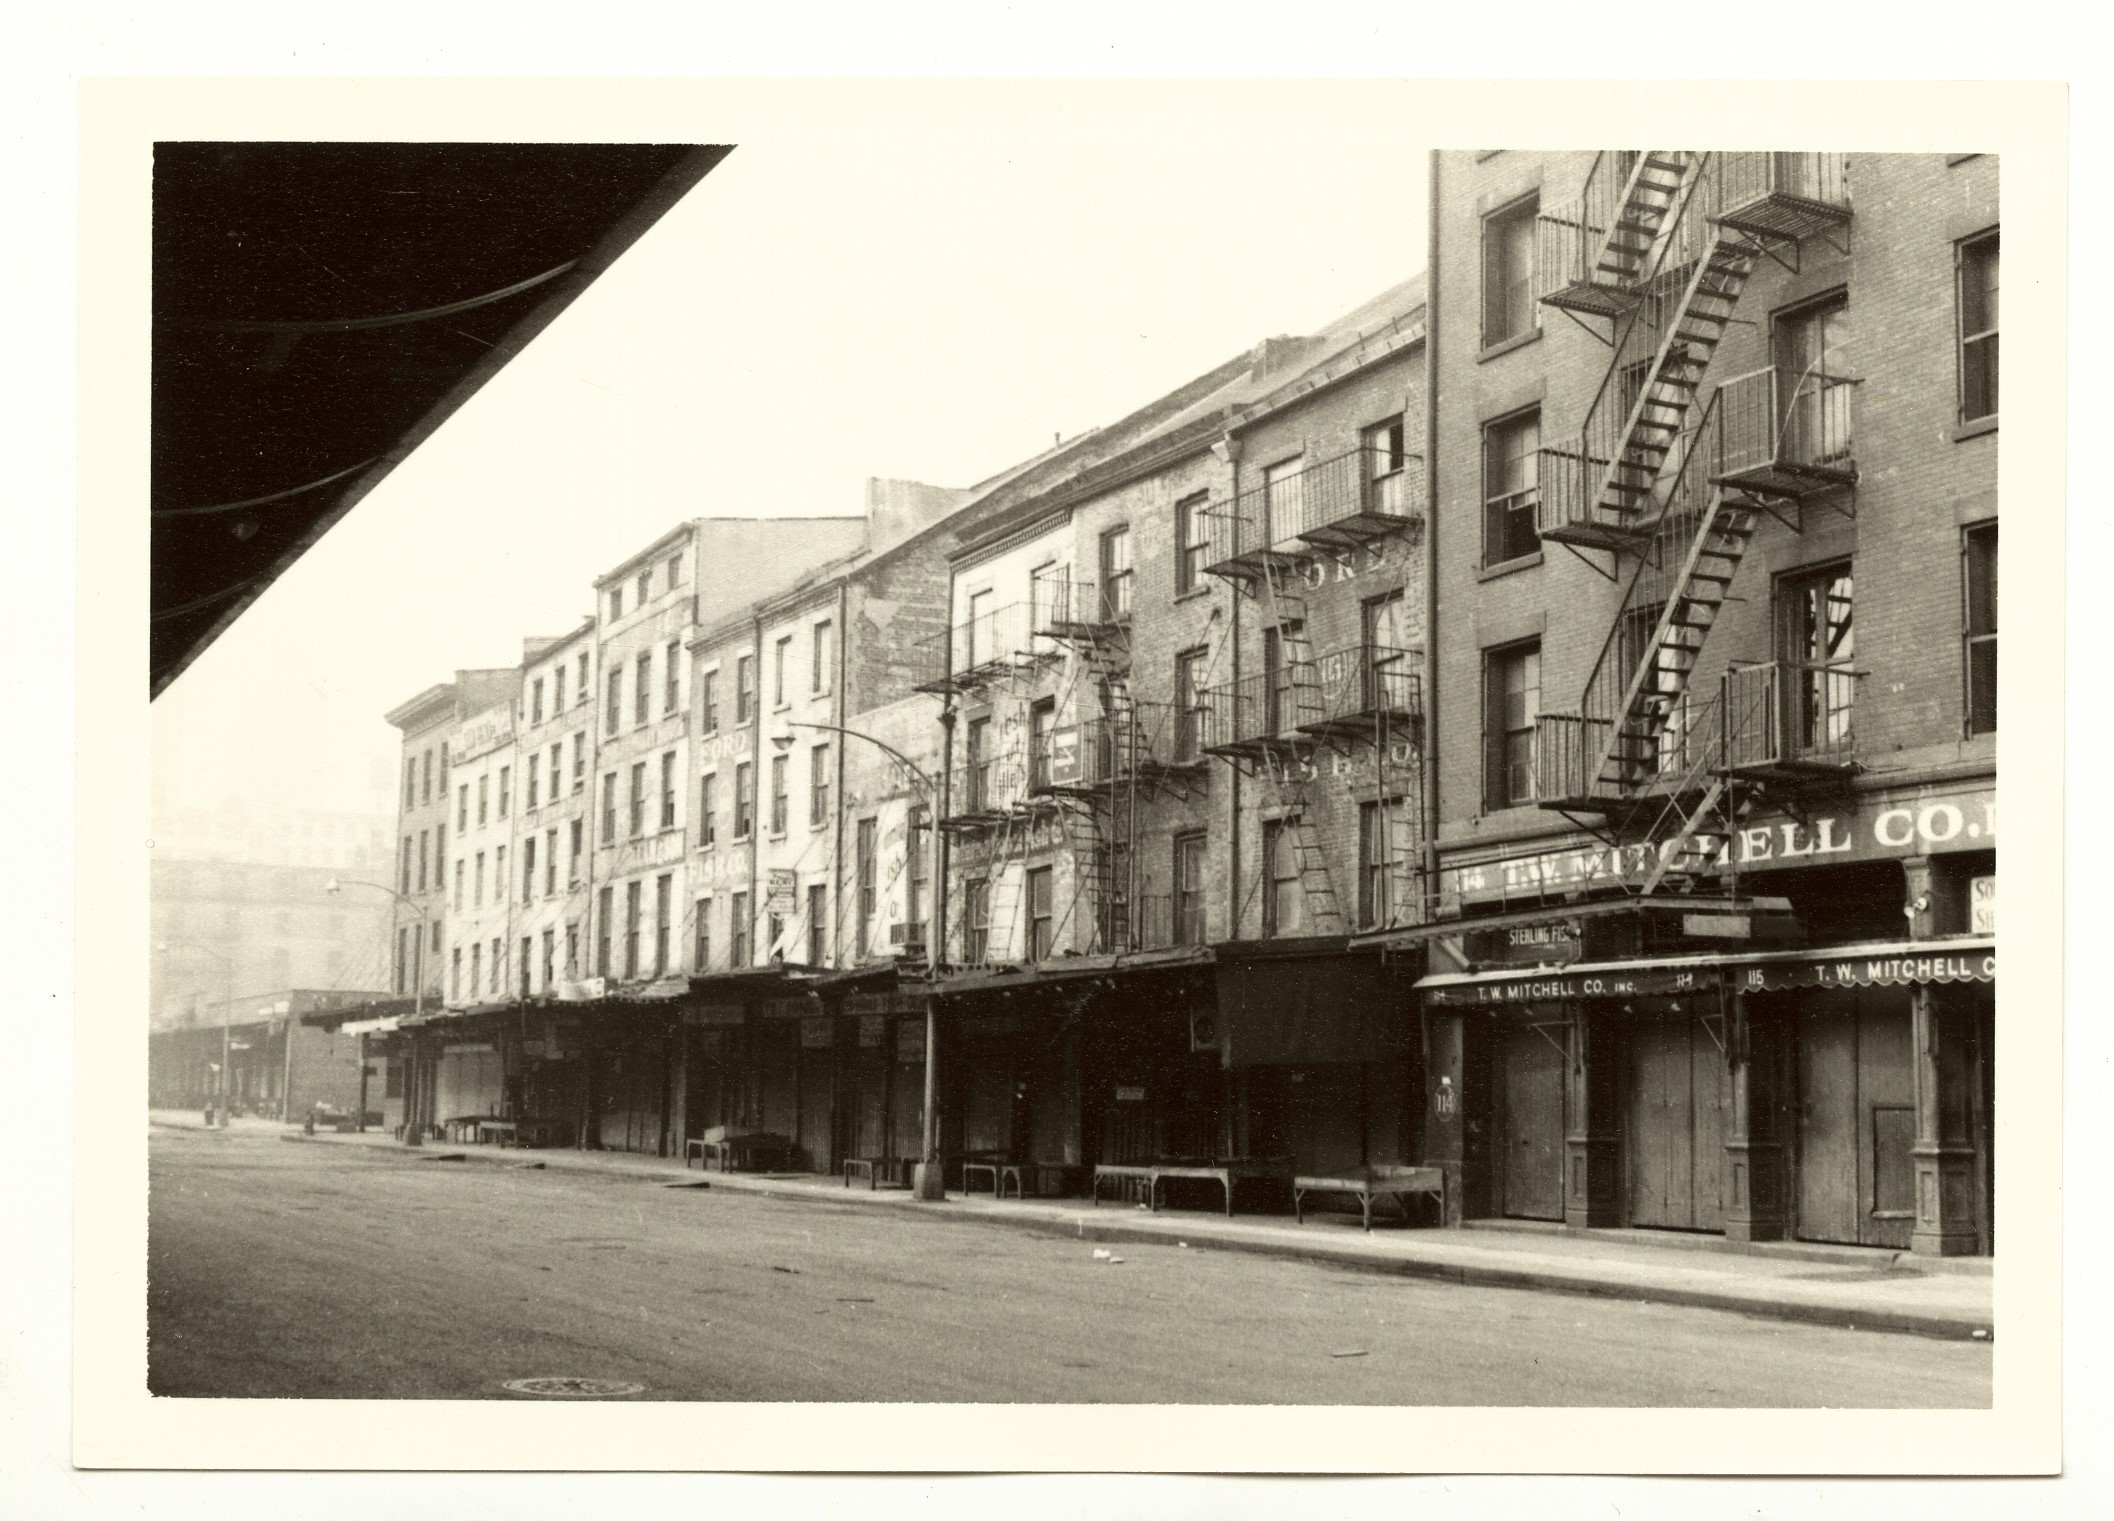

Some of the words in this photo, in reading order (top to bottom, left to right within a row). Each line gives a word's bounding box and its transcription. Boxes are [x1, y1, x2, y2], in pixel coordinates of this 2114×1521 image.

[1570, 818, 1852, 884] MITCHELL
[1509, 926, 1550, 946] STERLING
[1748, 969, 1764, 985] 115
[1867, 957, 1971, 979] MITCHELL
[1507, 982, 1575, 998] MITCHELL
[1583, 979, 1606, 994] CO.
[1615, 981, 1637, 992] INC.
